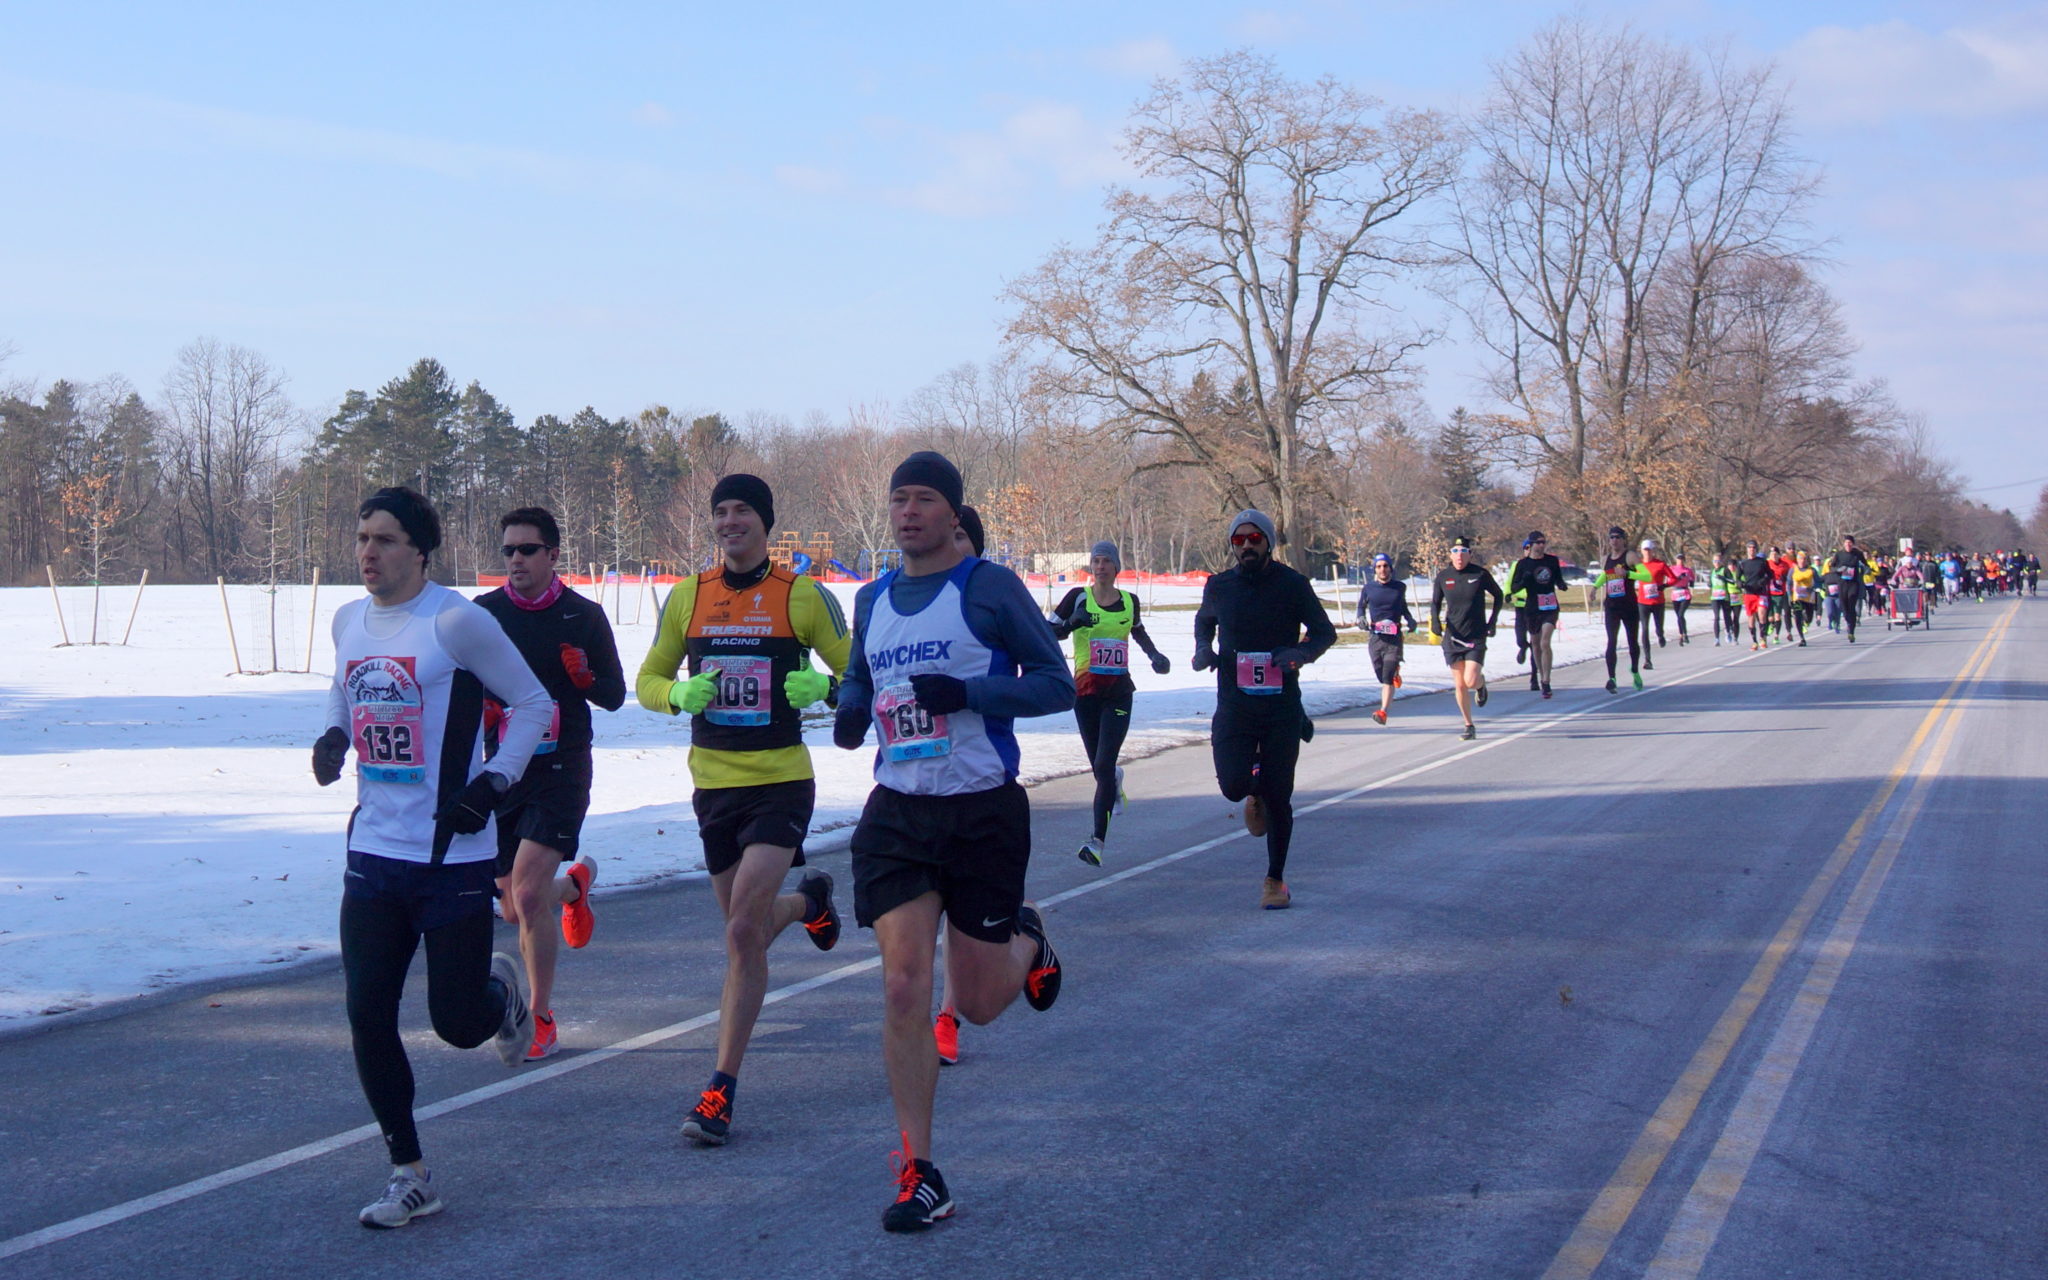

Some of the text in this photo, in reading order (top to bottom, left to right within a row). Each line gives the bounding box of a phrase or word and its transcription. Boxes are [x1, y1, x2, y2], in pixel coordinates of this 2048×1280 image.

[701, 625, 773, 635] TRUEPATH
[711, 638, 761, 646] RACING
[870, 640, 953, 673] PAYCHEX
[1096, 648, 1123, 665] 170
[347, 661, 413, 691] ROADKILL RACING
[1253, 665, 1265, 685] 5
[886, 702, 935, 741] 160
[361, 724, 413, 763] 132
